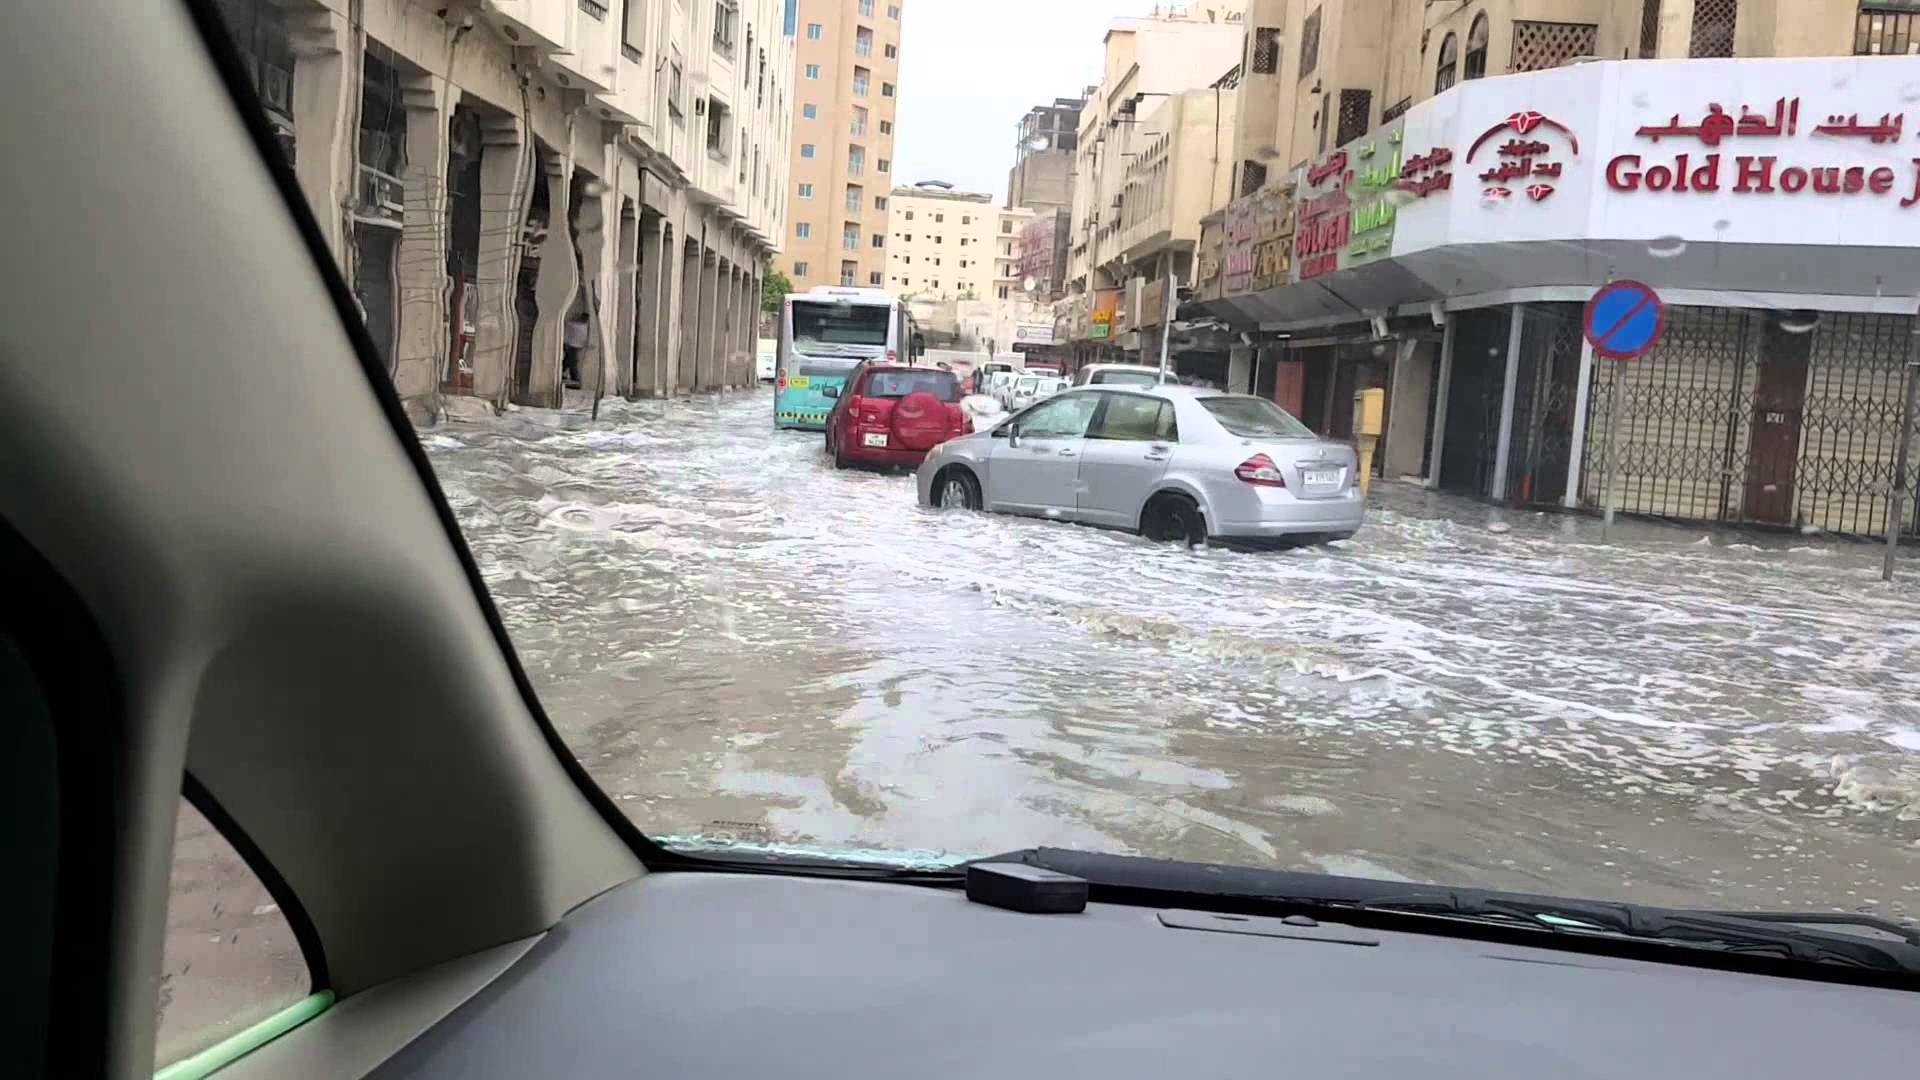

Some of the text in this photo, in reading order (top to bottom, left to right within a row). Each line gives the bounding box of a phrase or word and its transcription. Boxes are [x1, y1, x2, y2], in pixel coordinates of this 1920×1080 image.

[1635, 96, 1903, 146] بيت الذهب
[1606, 154, 1720, 193] Gold
[1733, 156, 1895, 193] House
